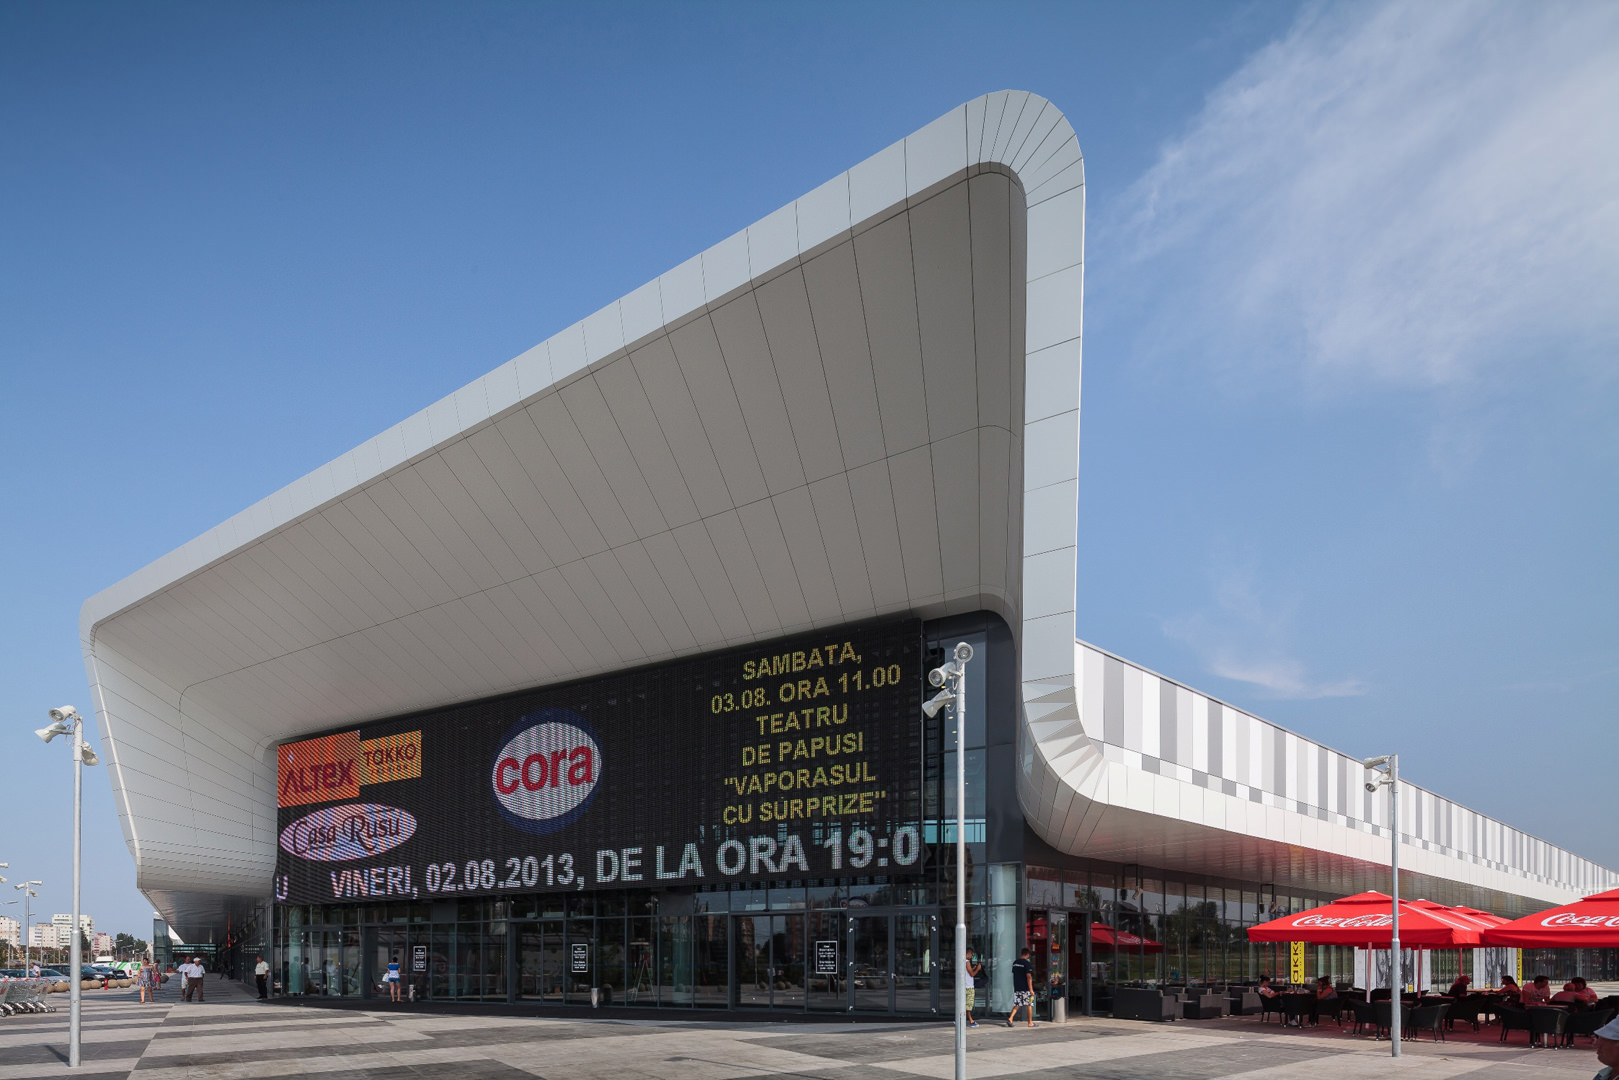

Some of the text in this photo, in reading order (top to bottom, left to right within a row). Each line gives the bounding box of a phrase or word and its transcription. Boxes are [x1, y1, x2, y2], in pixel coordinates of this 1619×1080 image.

[743, 641, 862, 680] SAMBATA,
[711, 664, 901, 714] 03.08. ORA 11.00
[756, 703, 849, 735] TEATRU
[742, 732, 863, 766] DE PAPUSI
[497, 746, 593, 794] cora
[724, 762, 876, 795] "VAPORASUL
[723, 790, 886, 824] CU SURPRIZE"
[293, 815, 400, 854] Casa Rusu
[330, 866, 418, 899] VINERI,
[425, 853, 585, 892] 02.08.2013,
[596, 848, 643, 883] DE
[656, 843, 705, 880] LA
[716, 835, 810, 876] ORA
[823, 827, 920, 869] 19:0
